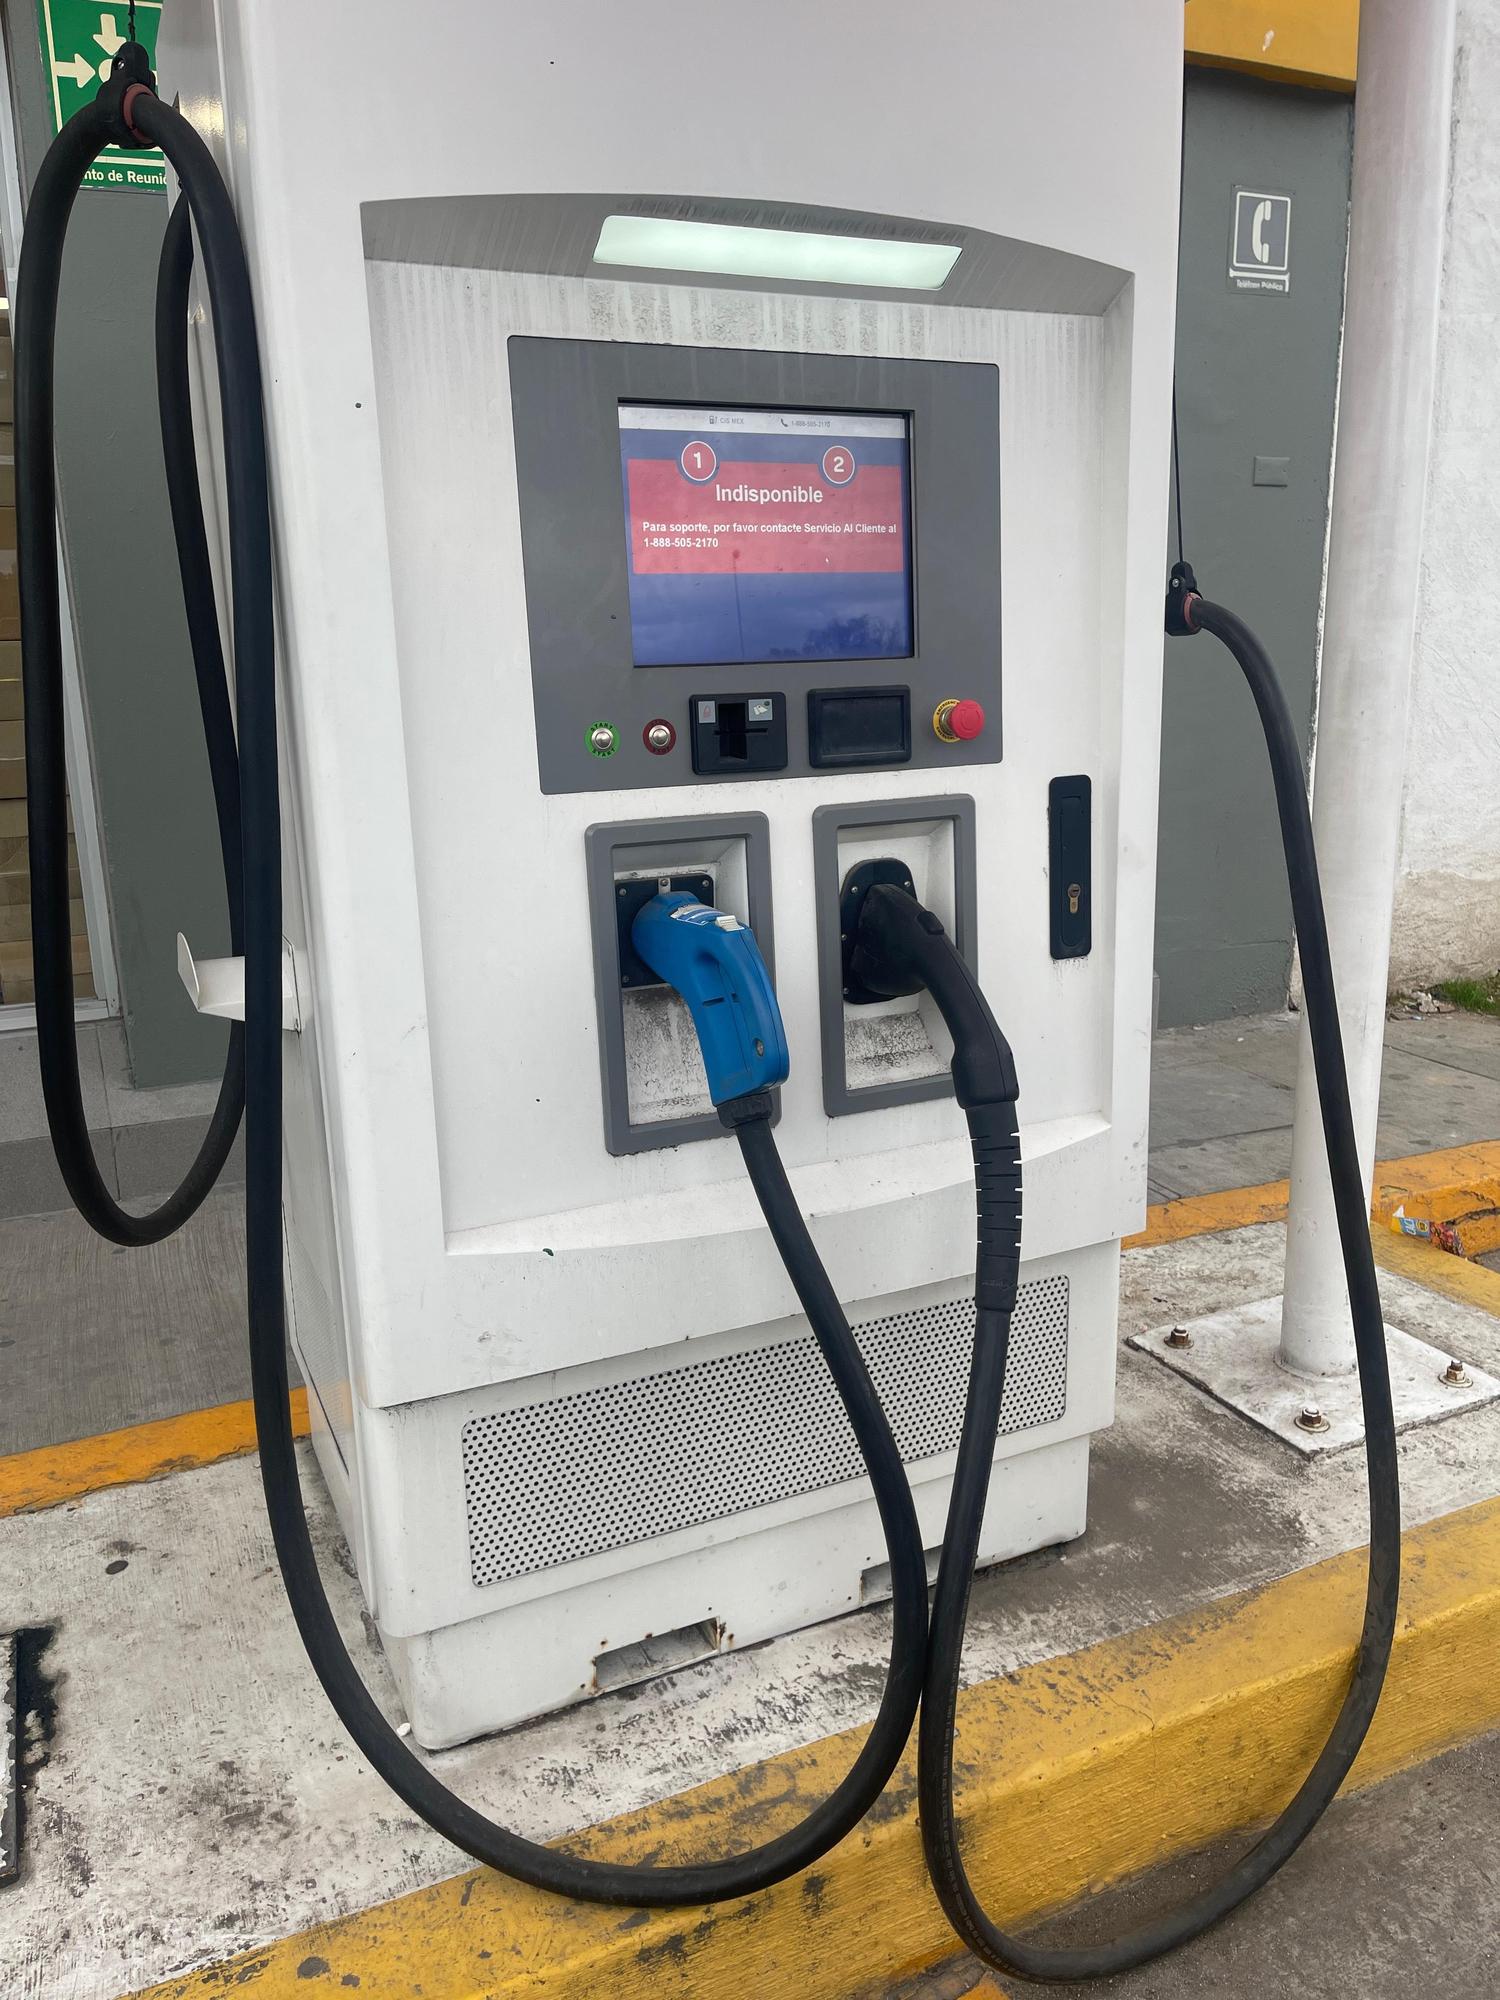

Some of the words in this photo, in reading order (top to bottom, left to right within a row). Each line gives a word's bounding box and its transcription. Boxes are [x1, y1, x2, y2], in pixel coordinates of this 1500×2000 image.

[84, 169, 104, 181] nto
[107, 170, 124, 182] de
[693, 452, 702, 469] 1
[833, 456, 845, 473] 2
[715, 484, 824, 505] Indisponible
[642, 521, 667, 532] Para
[669, 523, 711, 534] soporte,
[713, 524, 731, 534] por
[732, 523, 759, 533] favor
[760, 523, 802, 533] contacte
[803, 523, 842, 533] Servicio
[843, 523, 853, 533] Al
[855, 523, 887, 533] Cliente
[888, 523, 897, 533] al
[643, 537, 719, 548] 1-888-505-2170
[590, 722, 613, 732] START
